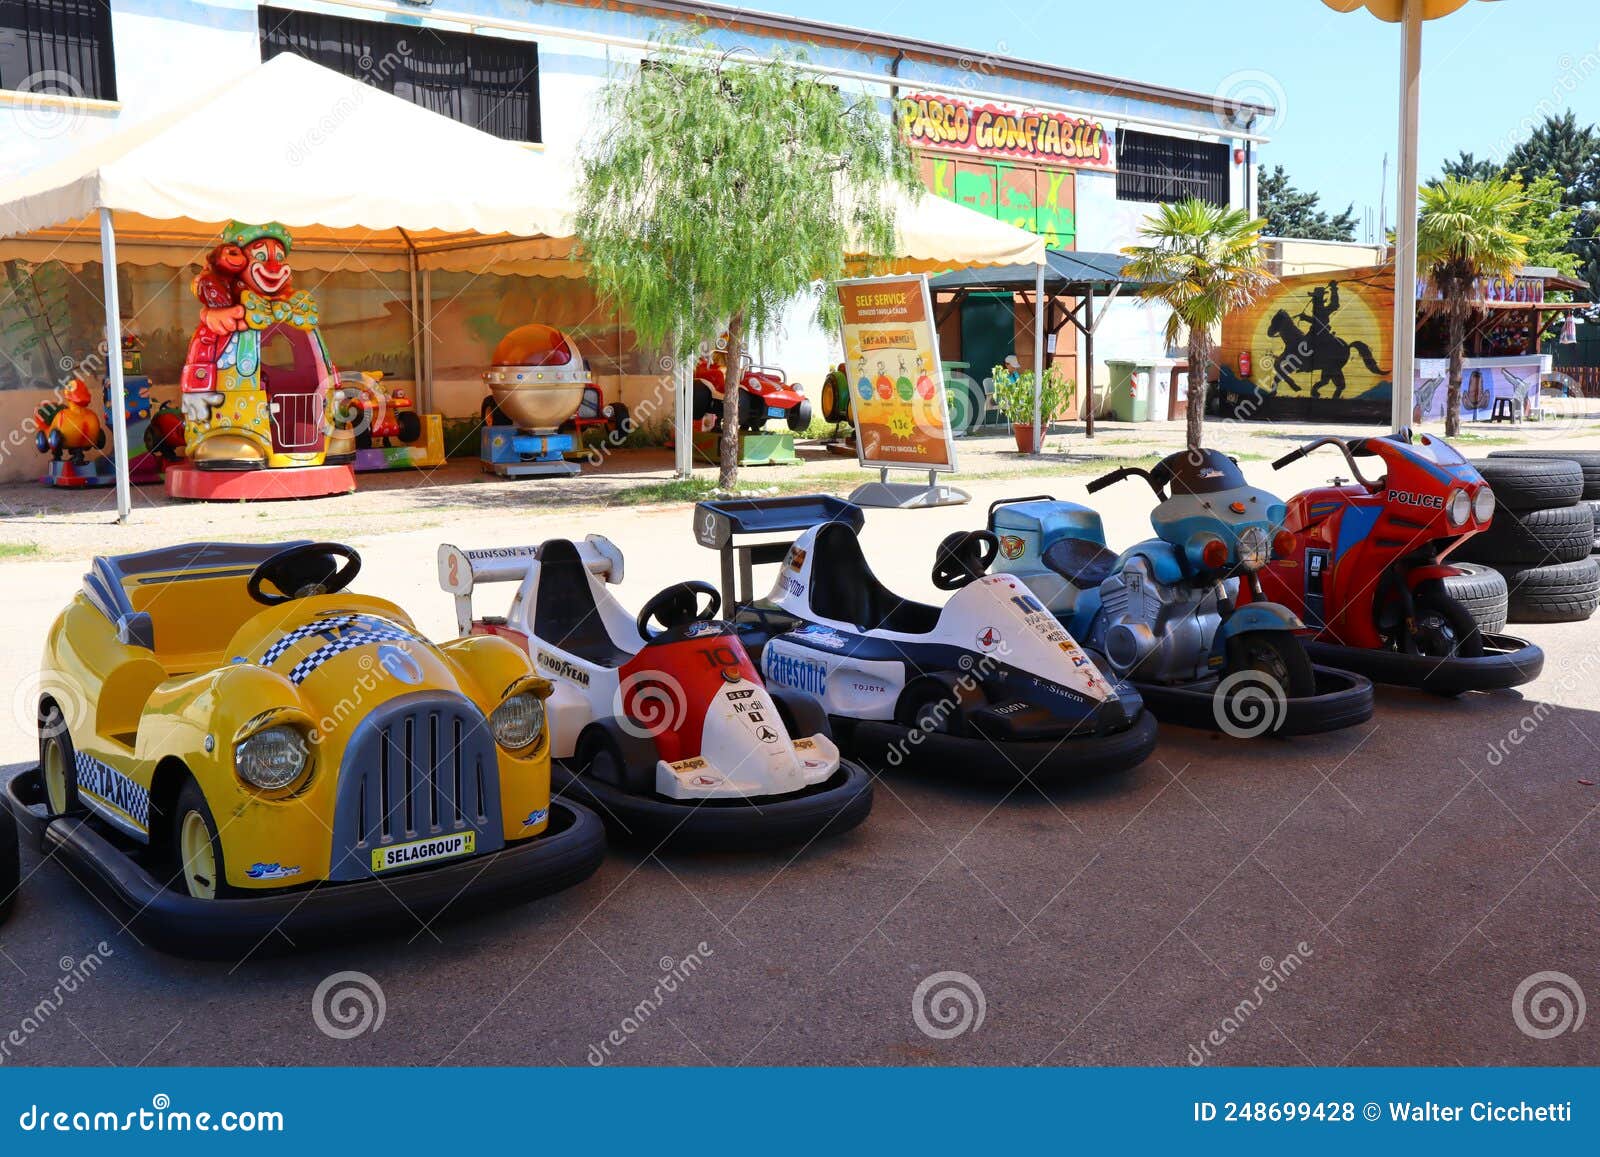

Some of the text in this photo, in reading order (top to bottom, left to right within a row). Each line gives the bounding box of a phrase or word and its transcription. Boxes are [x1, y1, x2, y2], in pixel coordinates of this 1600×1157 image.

[902, 98, 970, 144] PARCO
[856, 292, 907, 307] SELF SERVICE
[1389, 490, 1444, 509] POLICE
[468, 549, 516, 560] BUNSON
[448, 554, 459, 587] 2
[696, 647, 740, 668] 10
[767, 640, 827, 697] Panesonic
[853, 683, 886, 693] TOJOTA
[96, 762, 129, 812] TAXI
[387, 838, 462, 865] SELAGROUP
